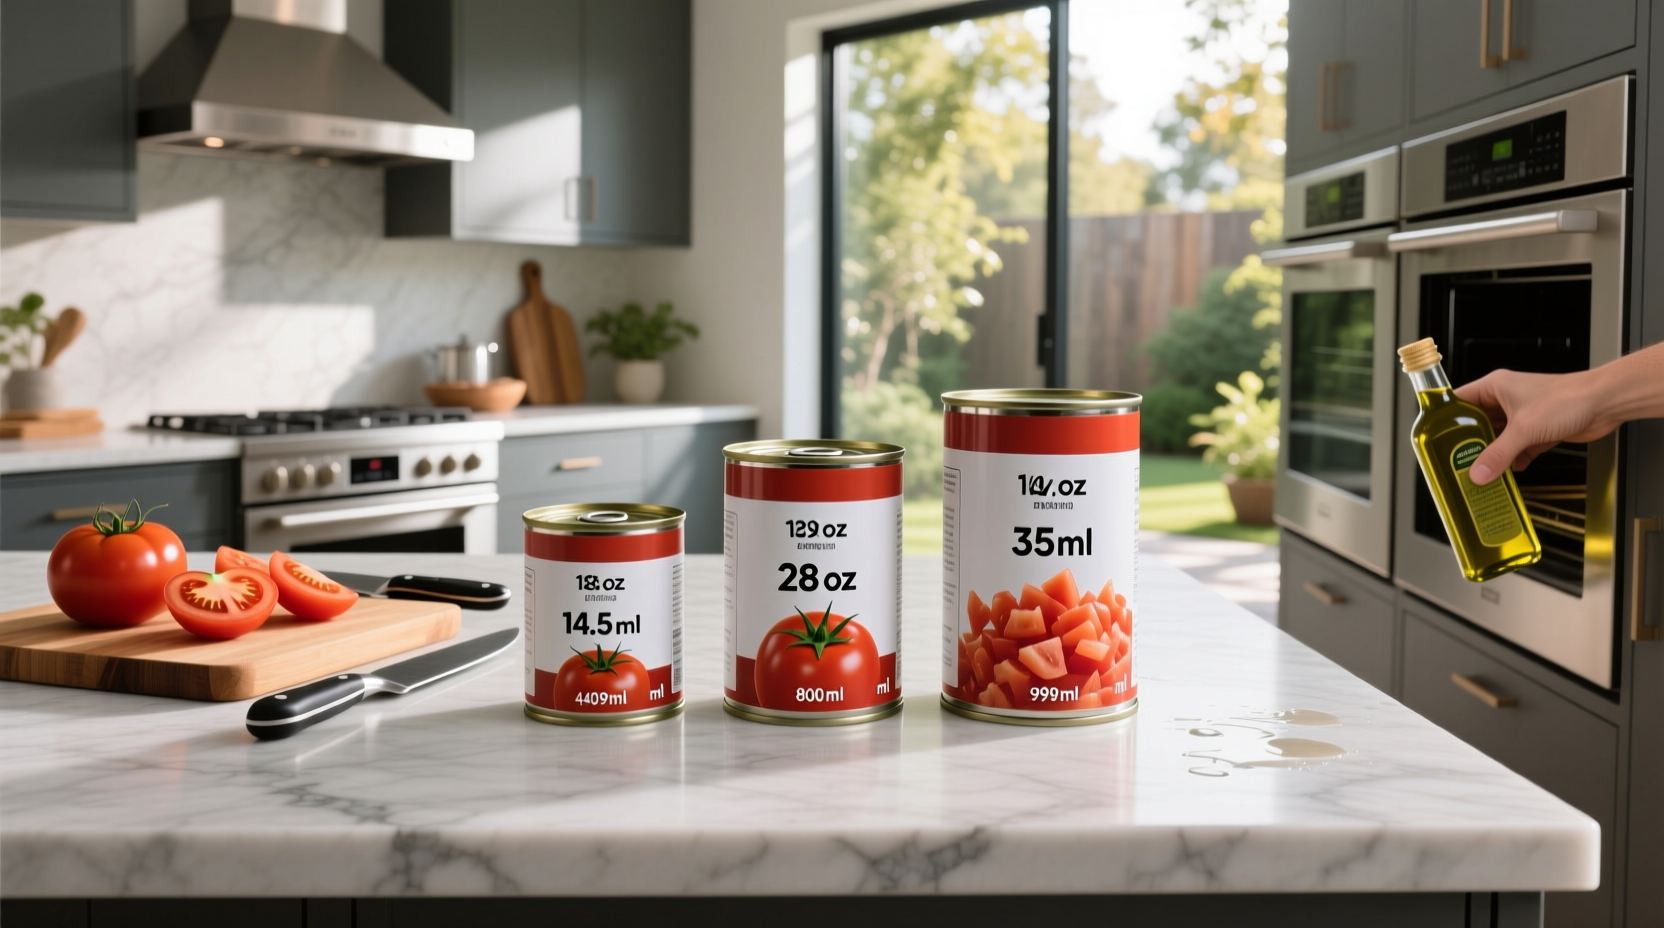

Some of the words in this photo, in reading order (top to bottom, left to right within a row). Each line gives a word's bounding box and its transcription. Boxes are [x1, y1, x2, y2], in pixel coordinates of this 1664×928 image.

[822, 523, 848, 538] oz
[777, 562, 820, 592] 28
[823, 571, 857, 592] oz
[649, 683, 664, 701] ml
[876, 677, 890, 695] ml
